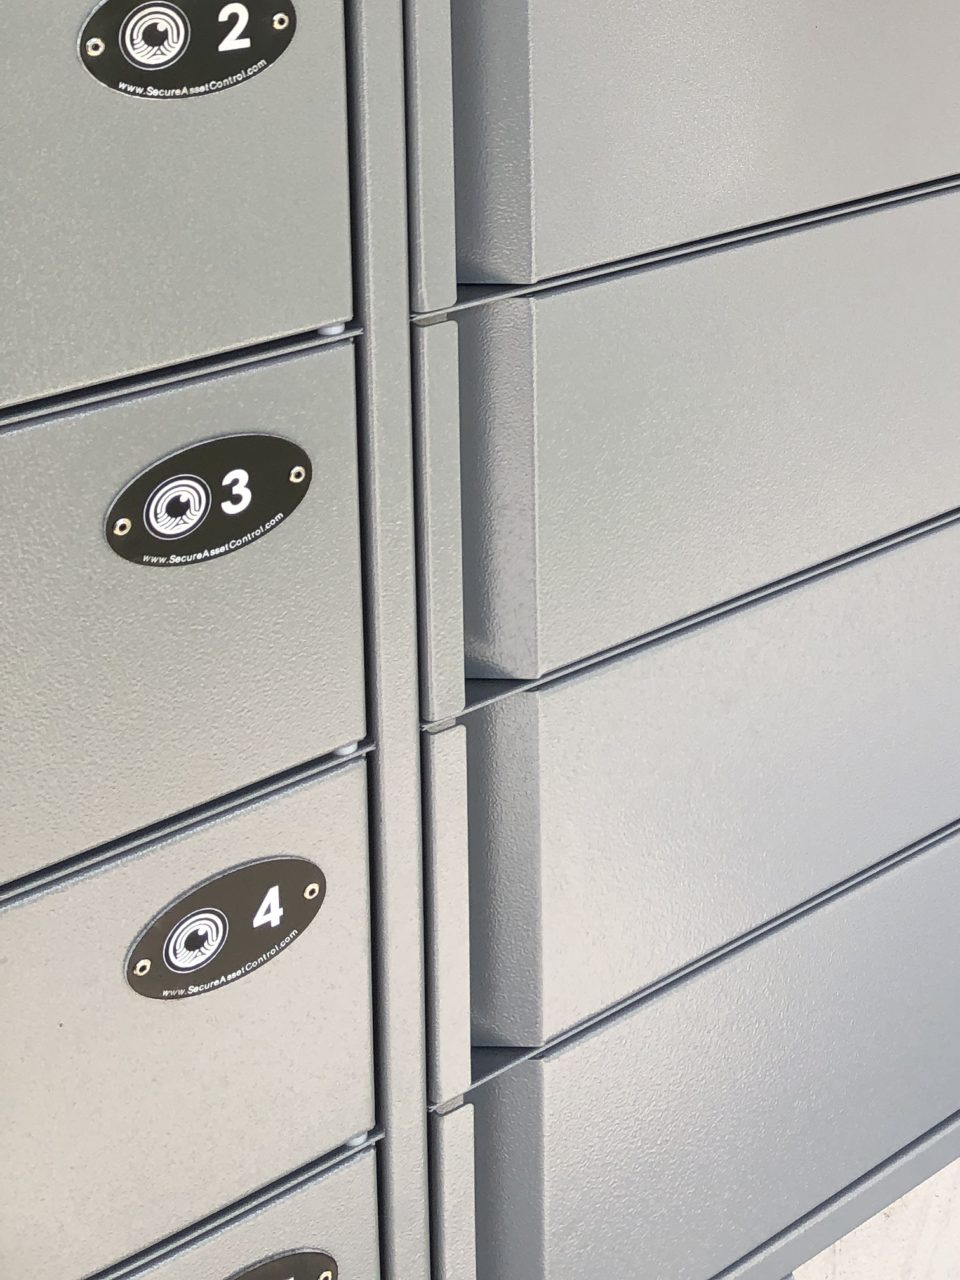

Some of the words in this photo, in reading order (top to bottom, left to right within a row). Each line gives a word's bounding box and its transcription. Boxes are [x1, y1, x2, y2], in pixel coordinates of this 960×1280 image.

[217, 2, 252, 52] 2
[118, 58, 267, 97] www.SecureAssetControl.com
[220, 468, 252, 515] 3
[142, 511, 284, 564] www.SecureAssetControl.com
[252, 884, 284, 929] 4
[162, 928, 298, 997] www.SecureAssetControl.com
